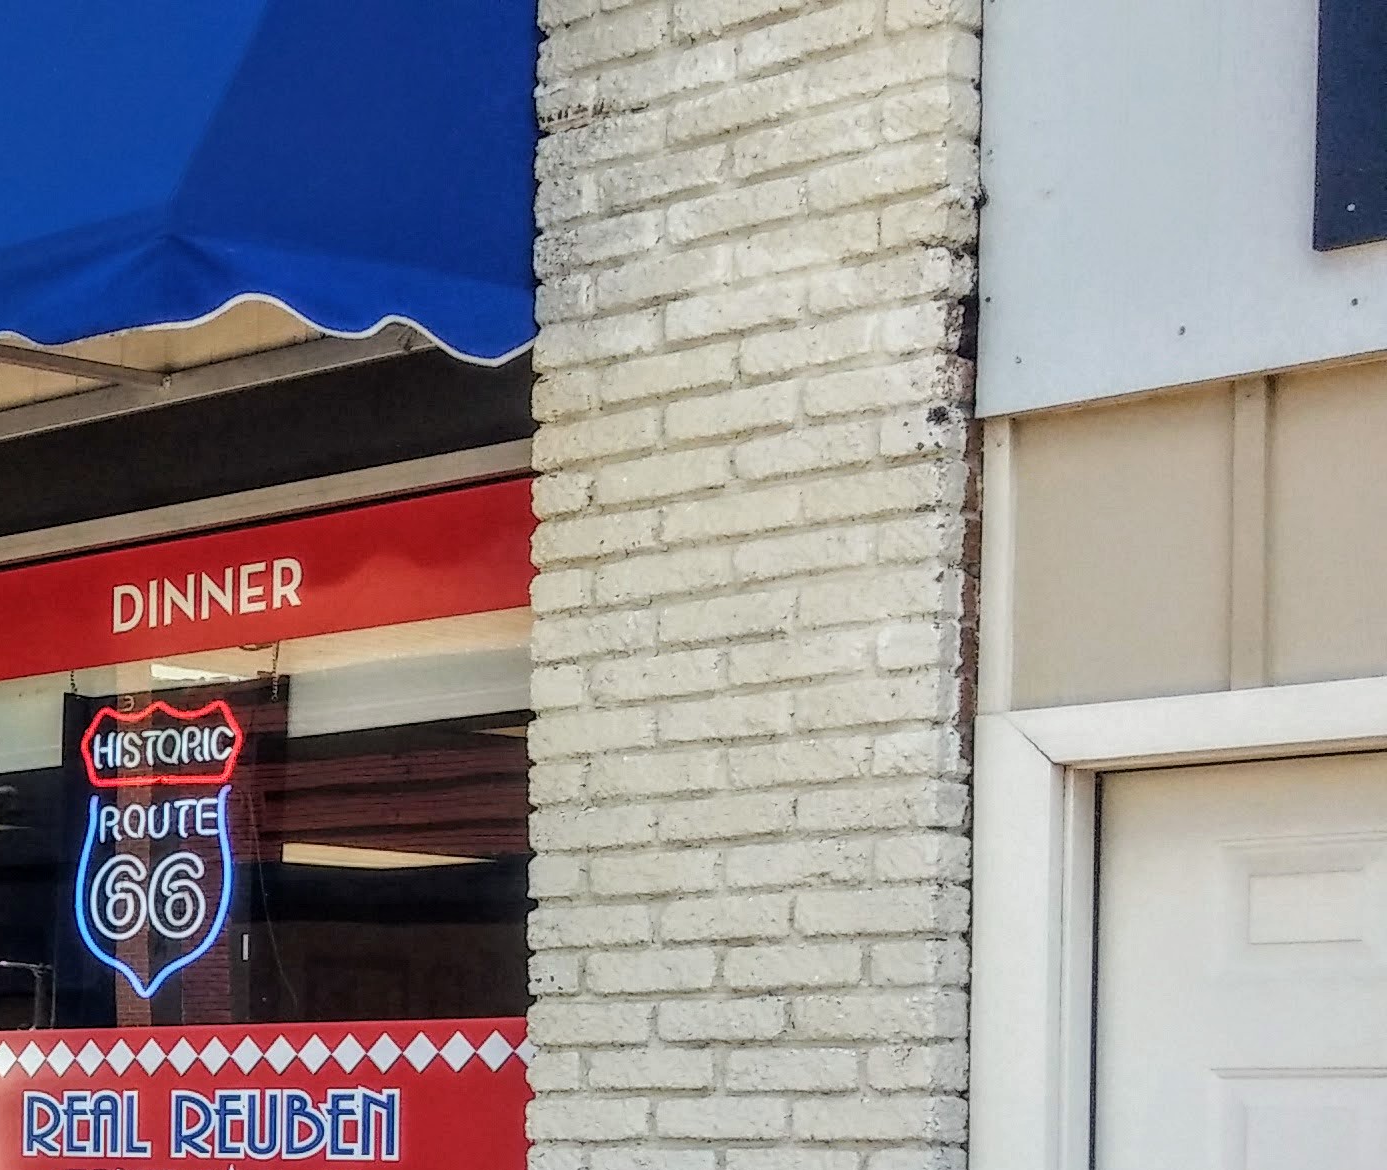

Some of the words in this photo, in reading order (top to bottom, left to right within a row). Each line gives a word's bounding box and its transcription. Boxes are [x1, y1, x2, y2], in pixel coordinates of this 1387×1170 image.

[112, 556, 304, 636] DINNER
[94, 726, 234, 769] HISTORIC
[100, 798, 219, 842] ROUTE
[90, 850, 205, 941] 66
[23, 1088, 152, 1158] REAL
[170, 1086, 401, 1161] REUBEN
